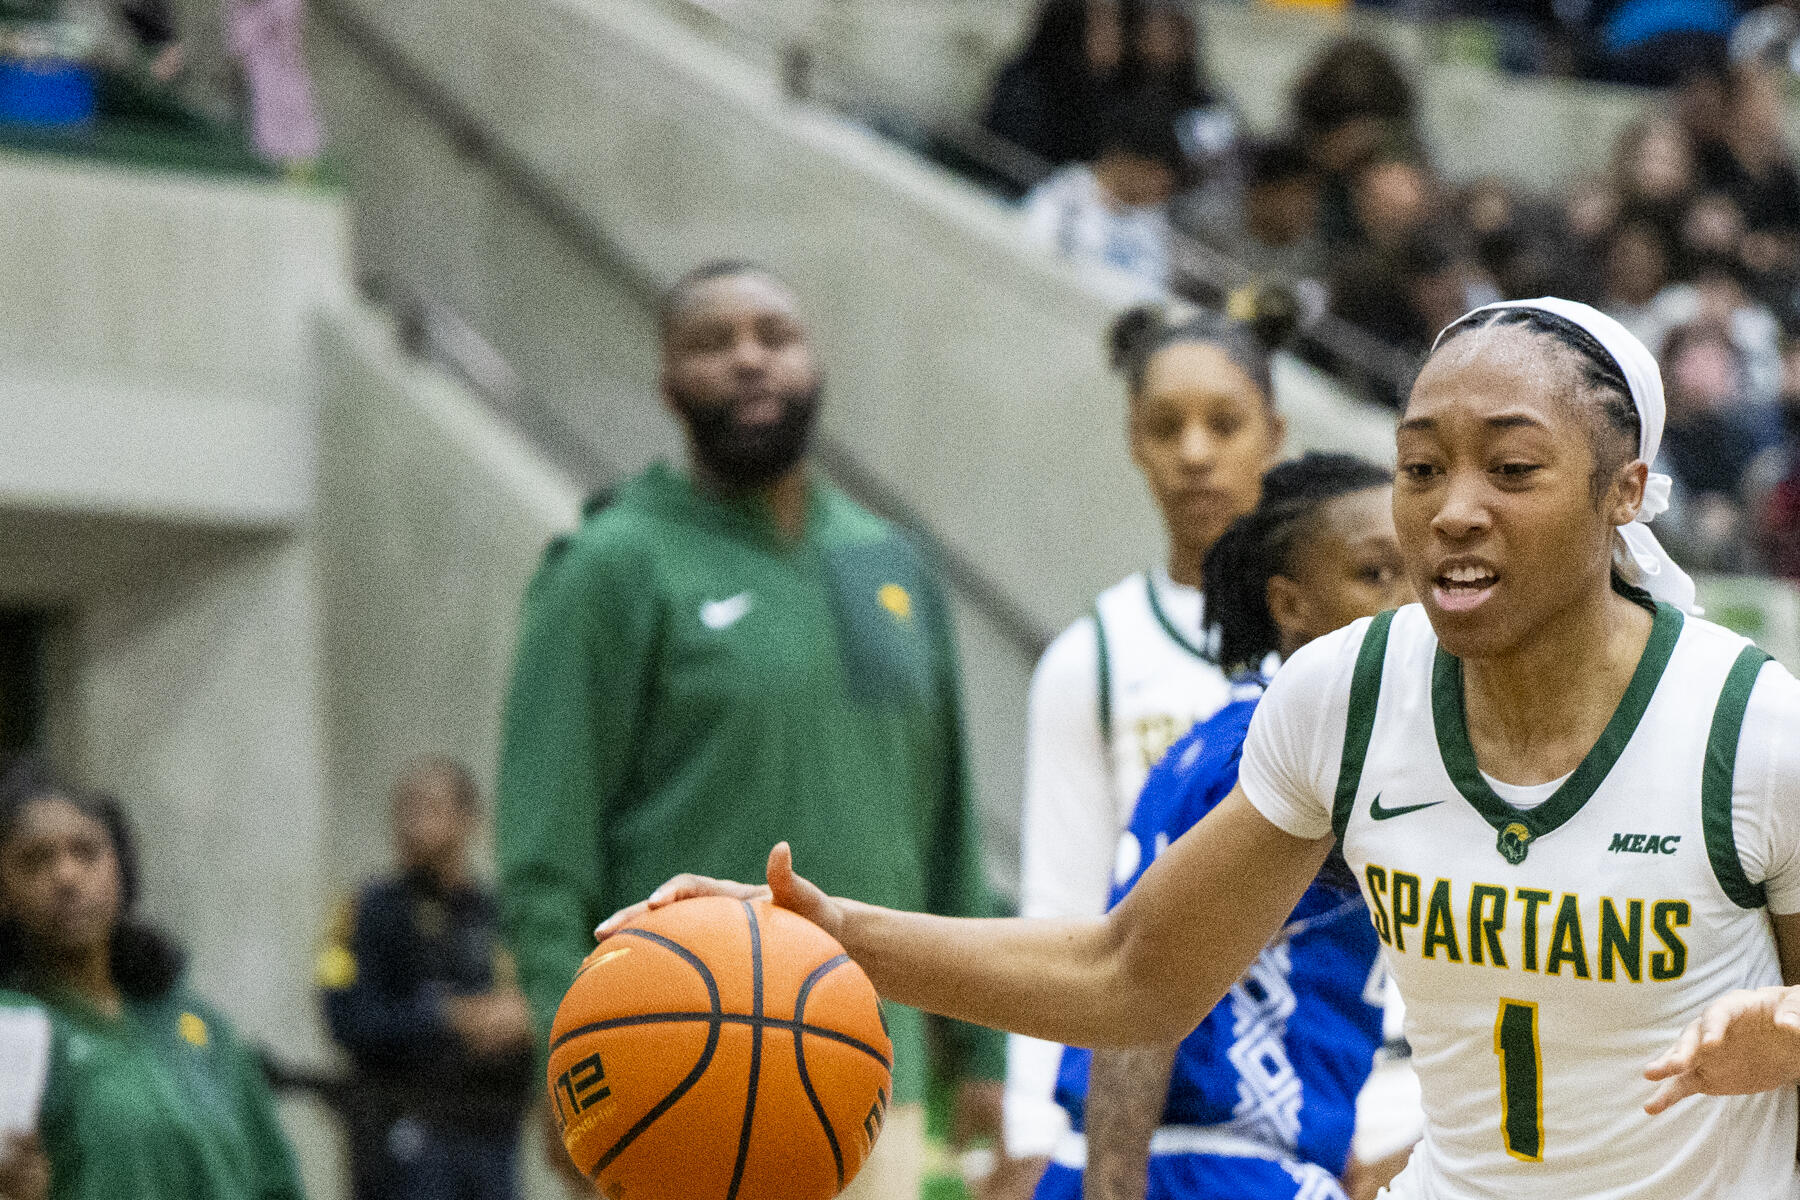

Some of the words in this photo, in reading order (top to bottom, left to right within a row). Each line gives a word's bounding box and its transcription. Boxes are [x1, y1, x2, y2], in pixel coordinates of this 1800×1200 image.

[1608, 832, 1682, 855] MEAC
[1364, 863, 1692, 984] SPARTANS
[1494, 996, 1545, 1164] 1
